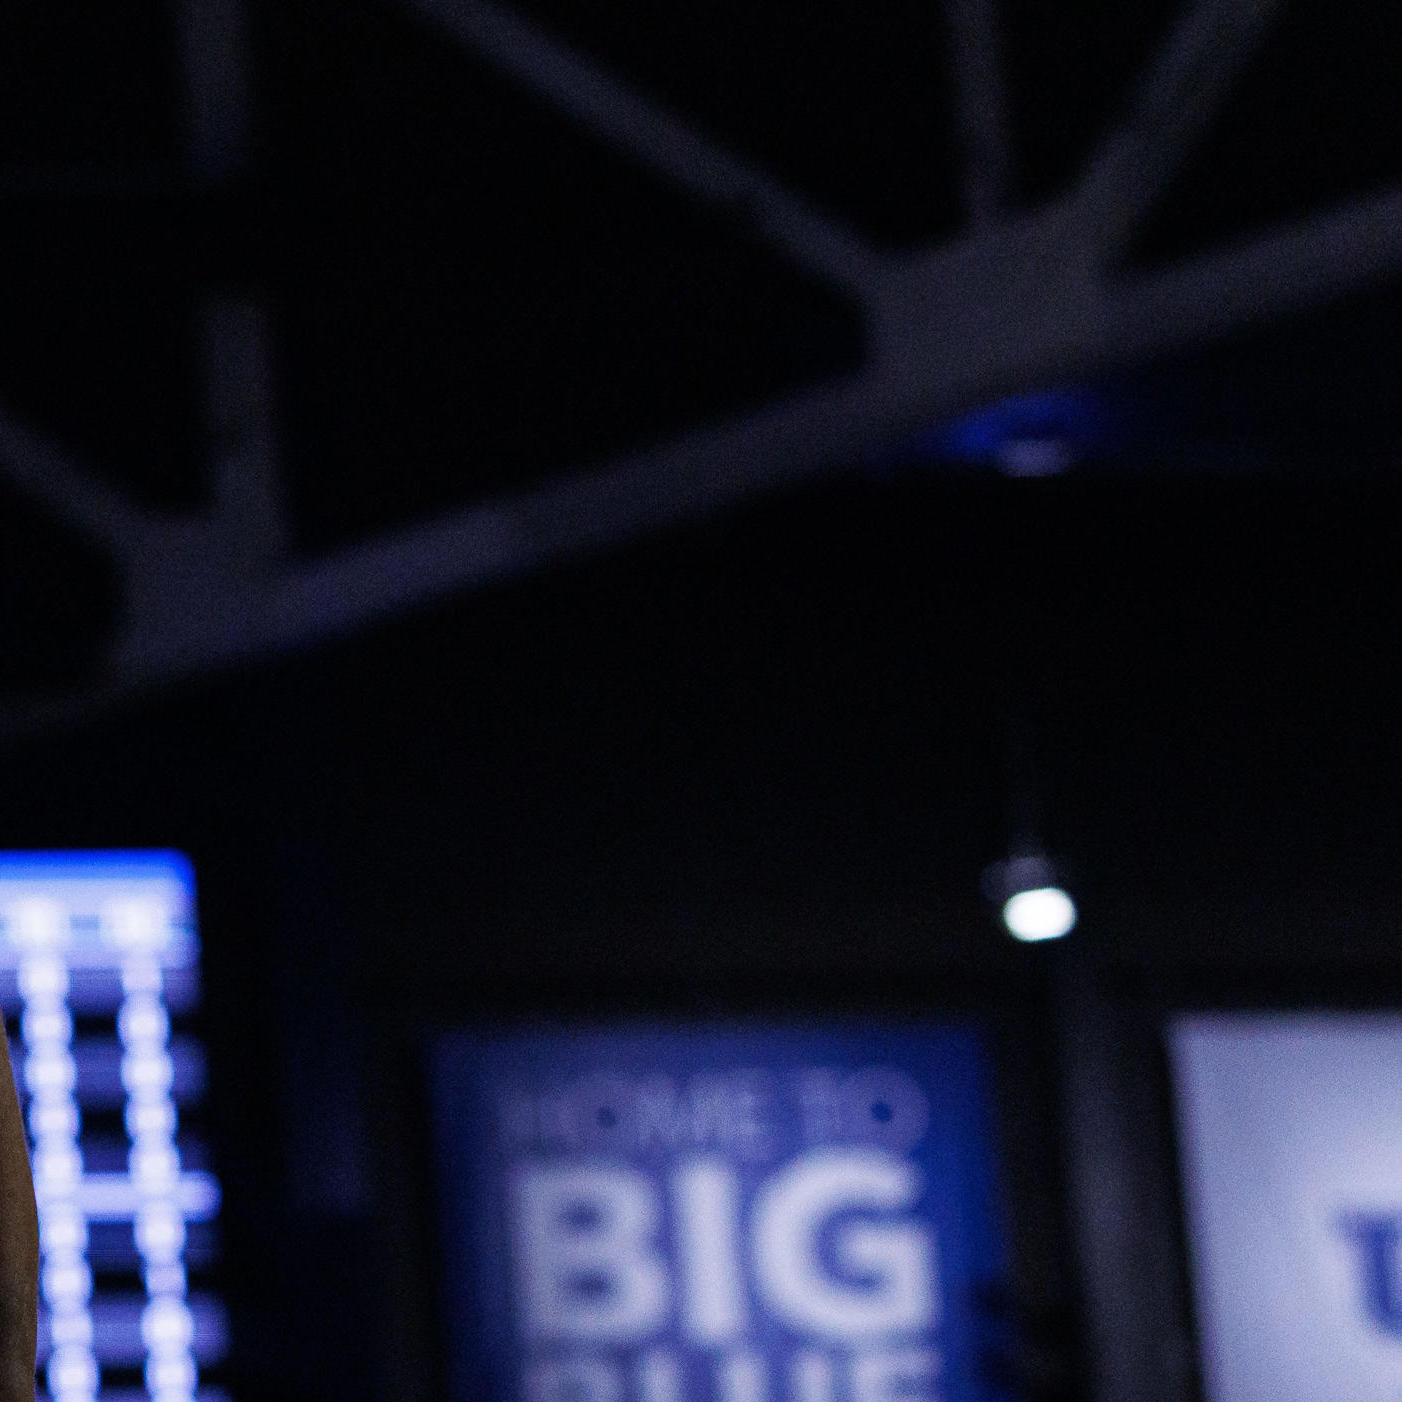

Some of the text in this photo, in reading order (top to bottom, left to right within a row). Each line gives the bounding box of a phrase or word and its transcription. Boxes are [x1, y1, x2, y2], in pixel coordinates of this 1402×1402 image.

[500, 1064, 931, 1153] HOME TO
[509, 1149, 939, 1347] BIG
